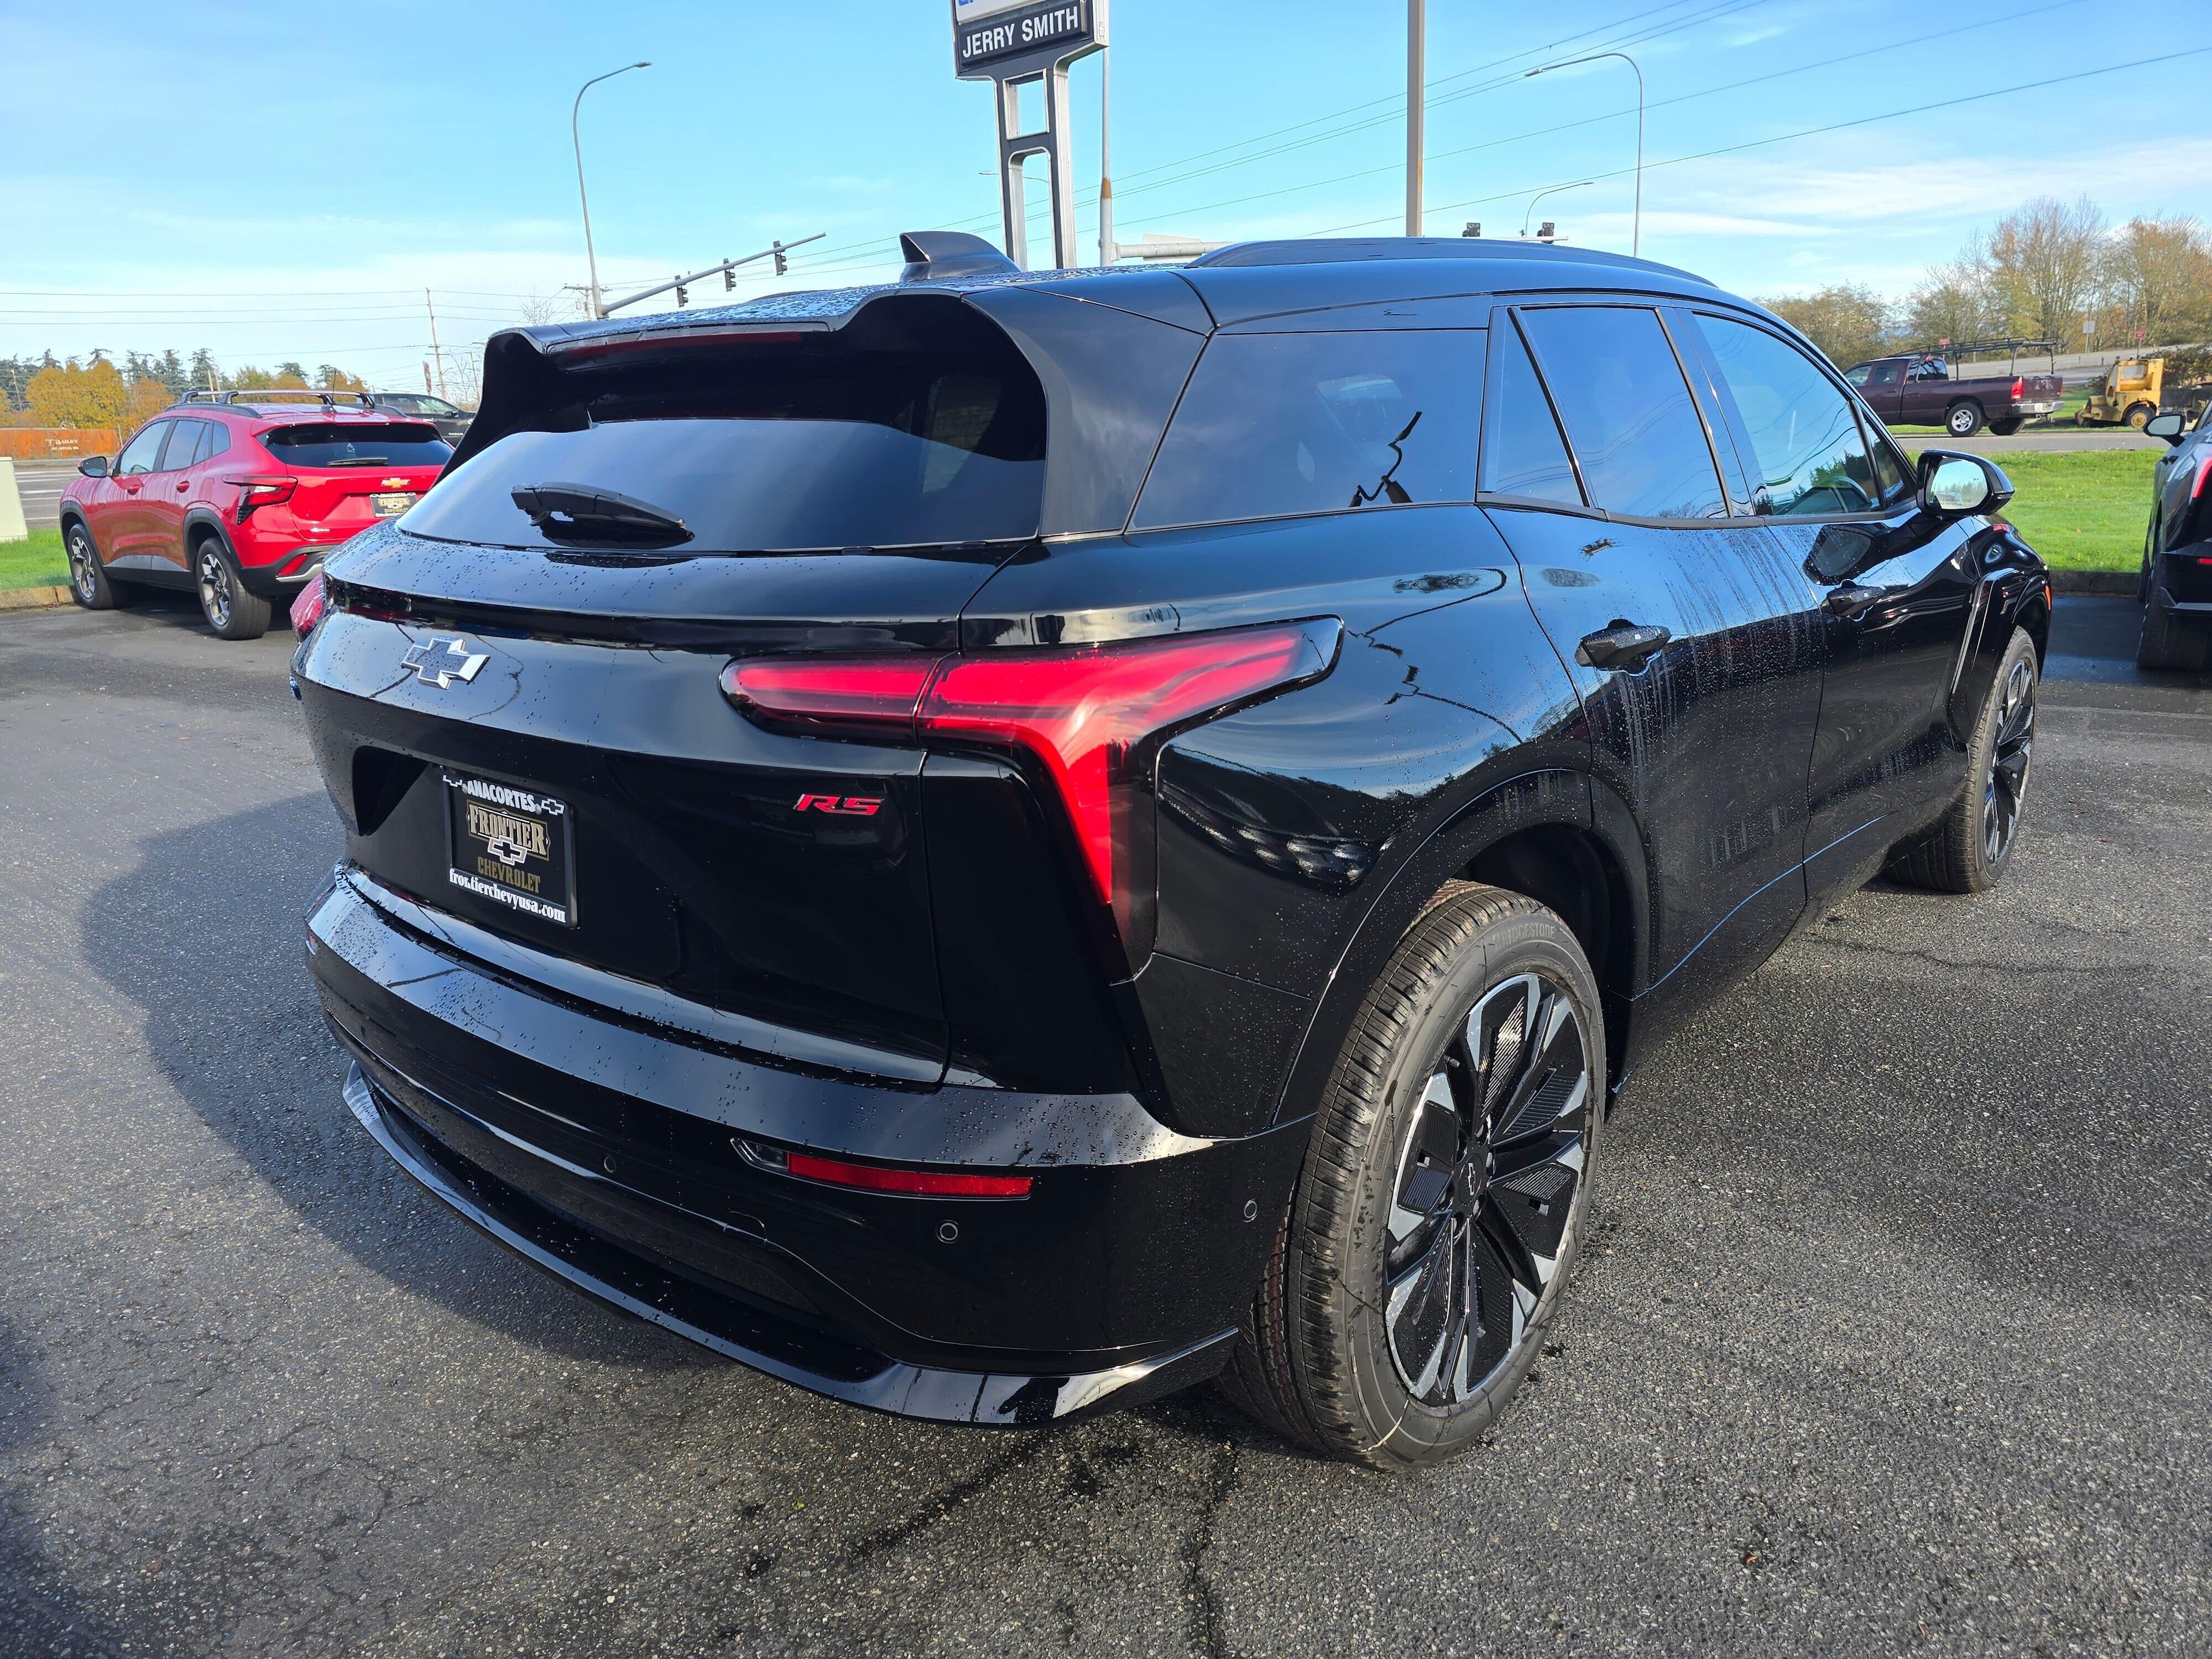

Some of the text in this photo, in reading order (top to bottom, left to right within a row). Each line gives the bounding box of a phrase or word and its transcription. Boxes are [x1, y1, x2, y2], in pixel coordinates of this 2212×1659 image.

[963, 6, 1078, 58] JERRY SMITH
[467, 780, 536, 812] ANACORTES
[793, 794, 884, 816] RS
[469, 804, 546, 855] FRONTIER
[478, 857, 541, 893] CHEVROLET
[450, 868, 566, 923] frontierchevyusa.com
[1494, 922, 1556, 950] BRIDGESTONE
